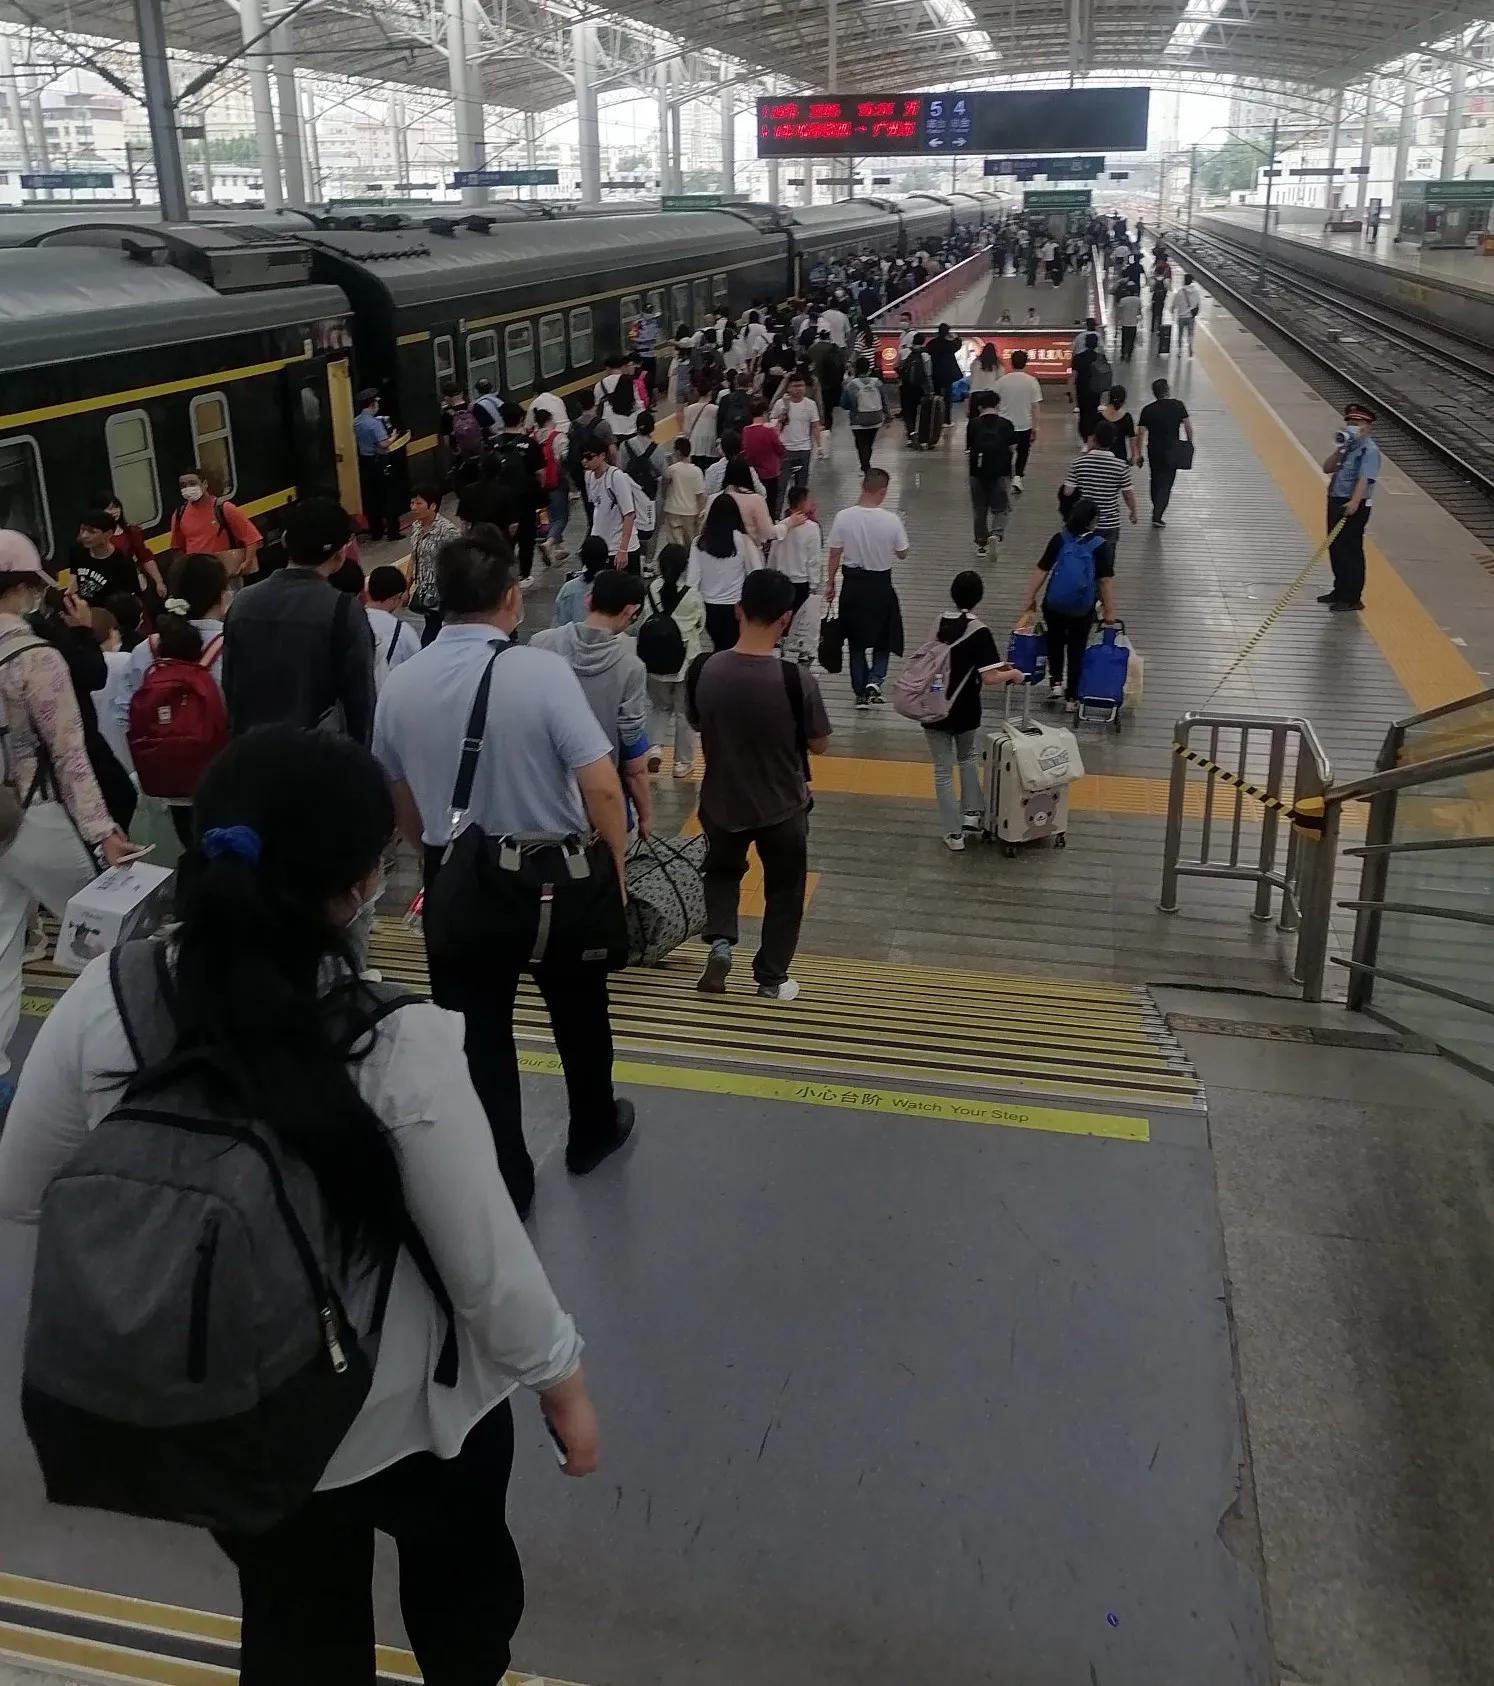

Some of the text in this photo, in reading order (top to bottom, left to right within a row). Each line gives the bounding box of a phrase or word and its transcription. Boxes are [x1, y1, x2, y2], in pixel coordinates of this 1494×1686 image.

[930, 100, 943, 117] 5
[953, 100, 966, 116] 4
[795, 1085, 1030, 1124] 小心台阶 Watch Your Step
